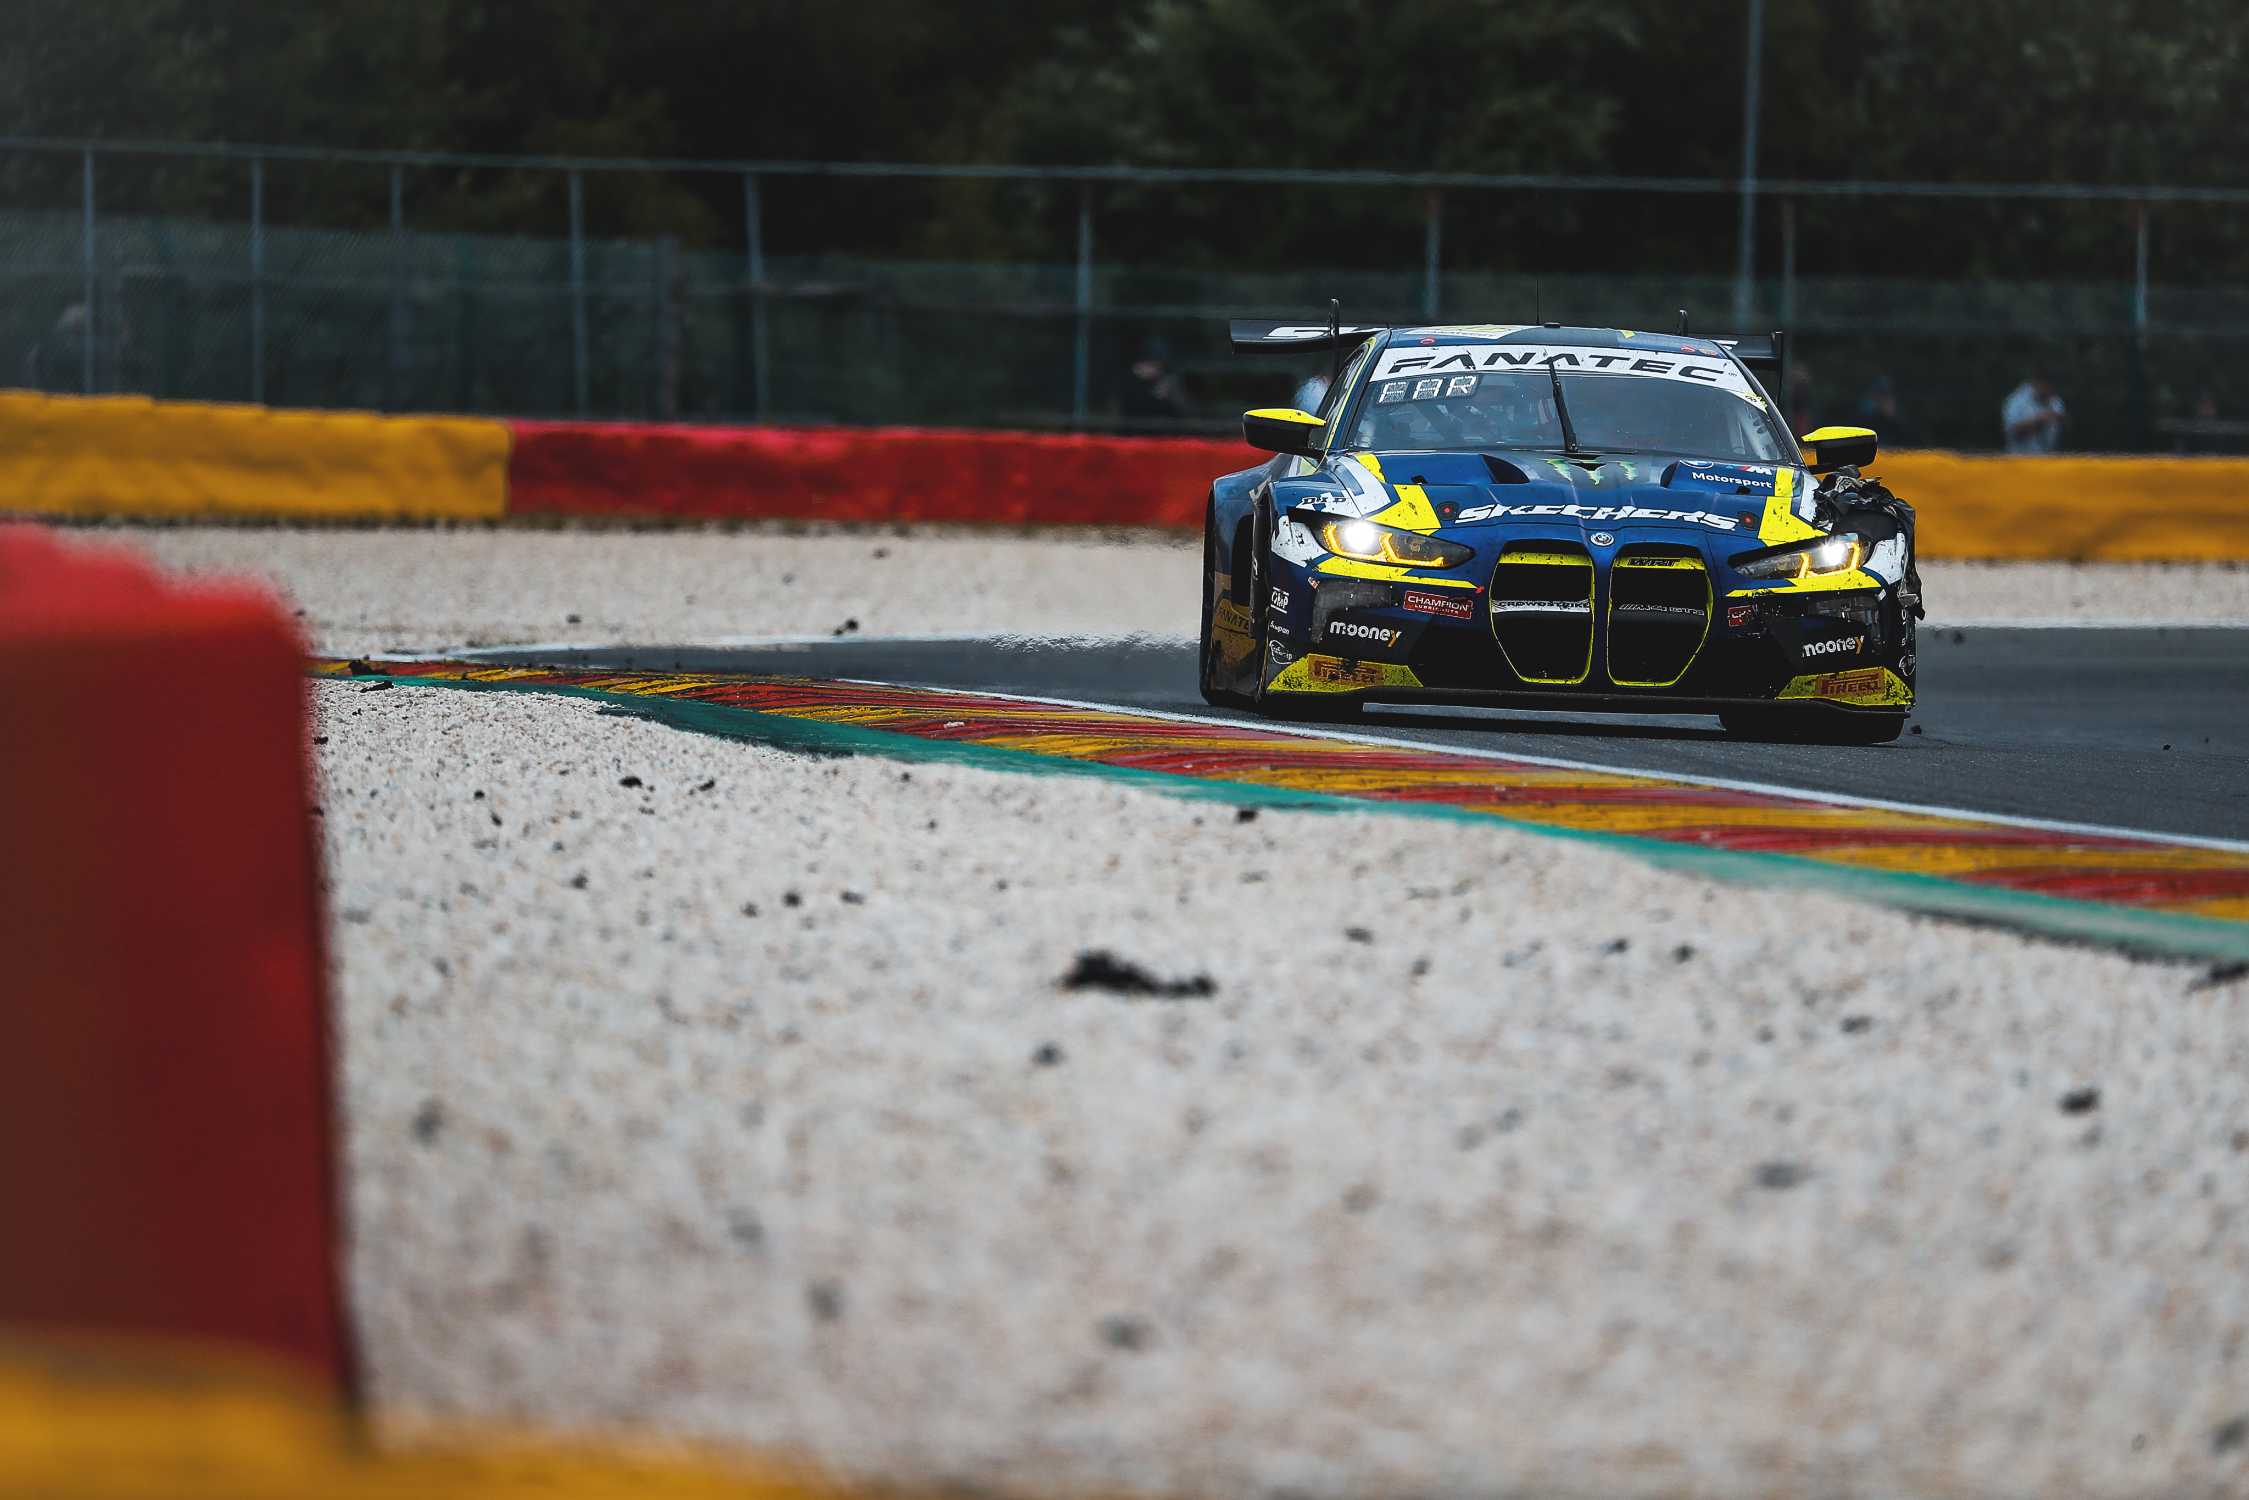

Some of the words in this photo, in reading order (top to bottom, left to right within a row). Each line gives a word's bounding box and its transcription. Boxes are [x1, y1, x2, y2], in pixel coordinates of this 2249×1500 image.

[1387, 351, 1723, 382] FANATEC
[1691, 471, 1773, 489] Motorsport
[1454, 503, 1739, 531] SKECHERS
[1407, 595, 1469, 612] CHAMPION
[1329, 621, 1402, 648] mooney
